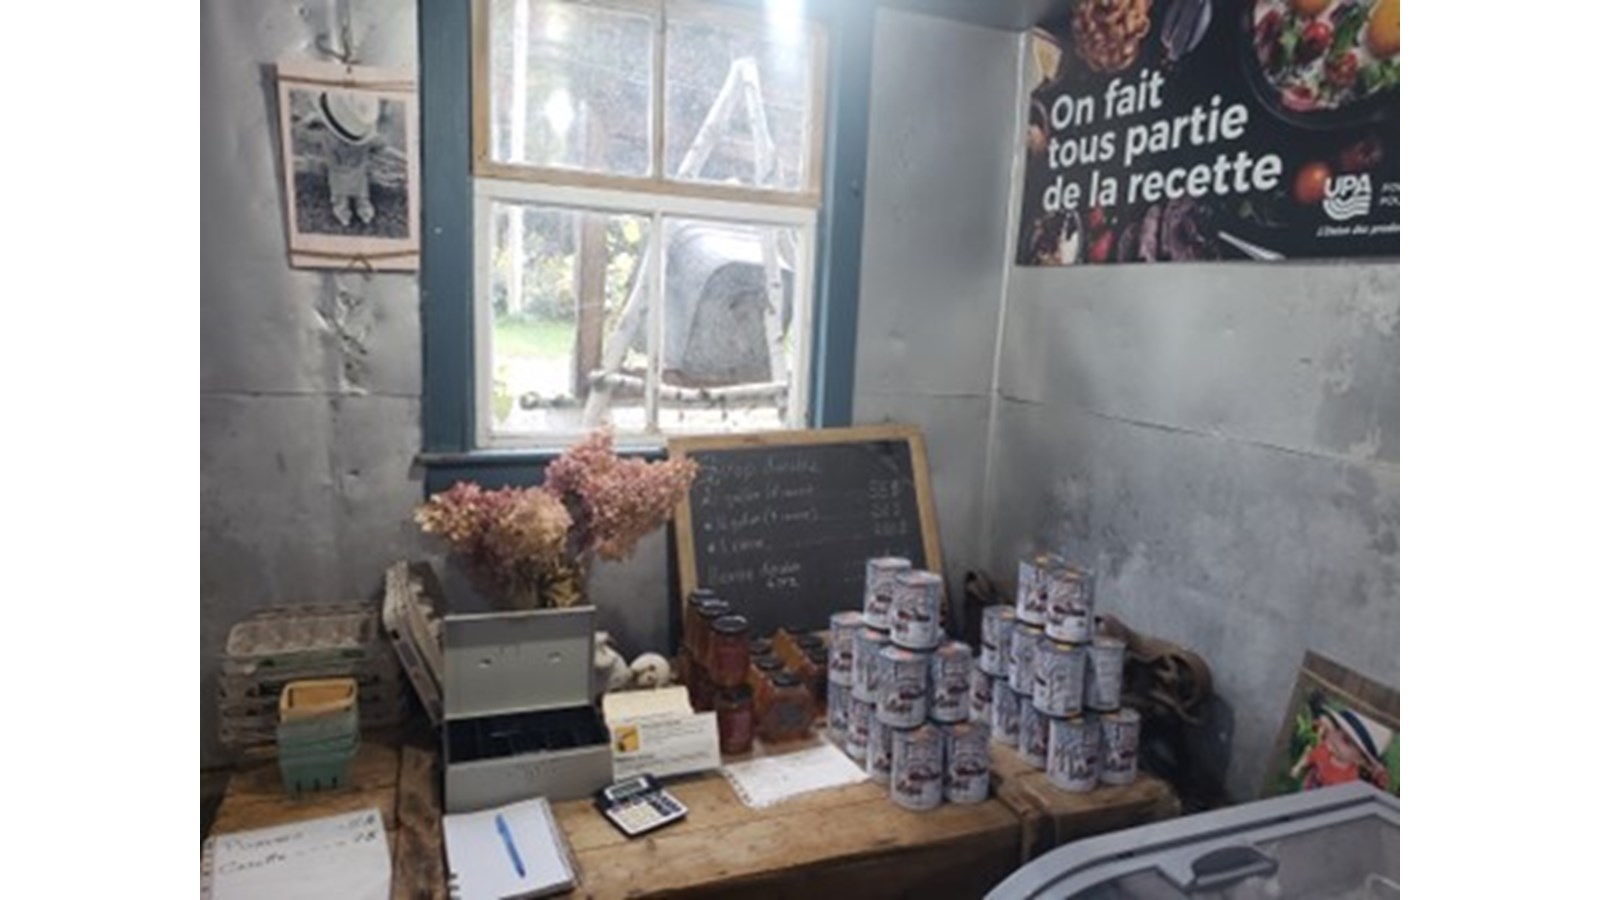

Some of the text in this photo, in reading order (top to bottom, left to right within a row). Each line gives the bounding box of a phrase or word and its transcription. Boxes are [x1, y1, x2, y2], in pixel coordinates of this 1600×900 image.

[1051, 68, 1165, 130] On fait
[1048, 95, 1249, 169] tous partie
[1043, 151, 1283, 211] de la recette
[1324, 173, 1371, 198] UPA
